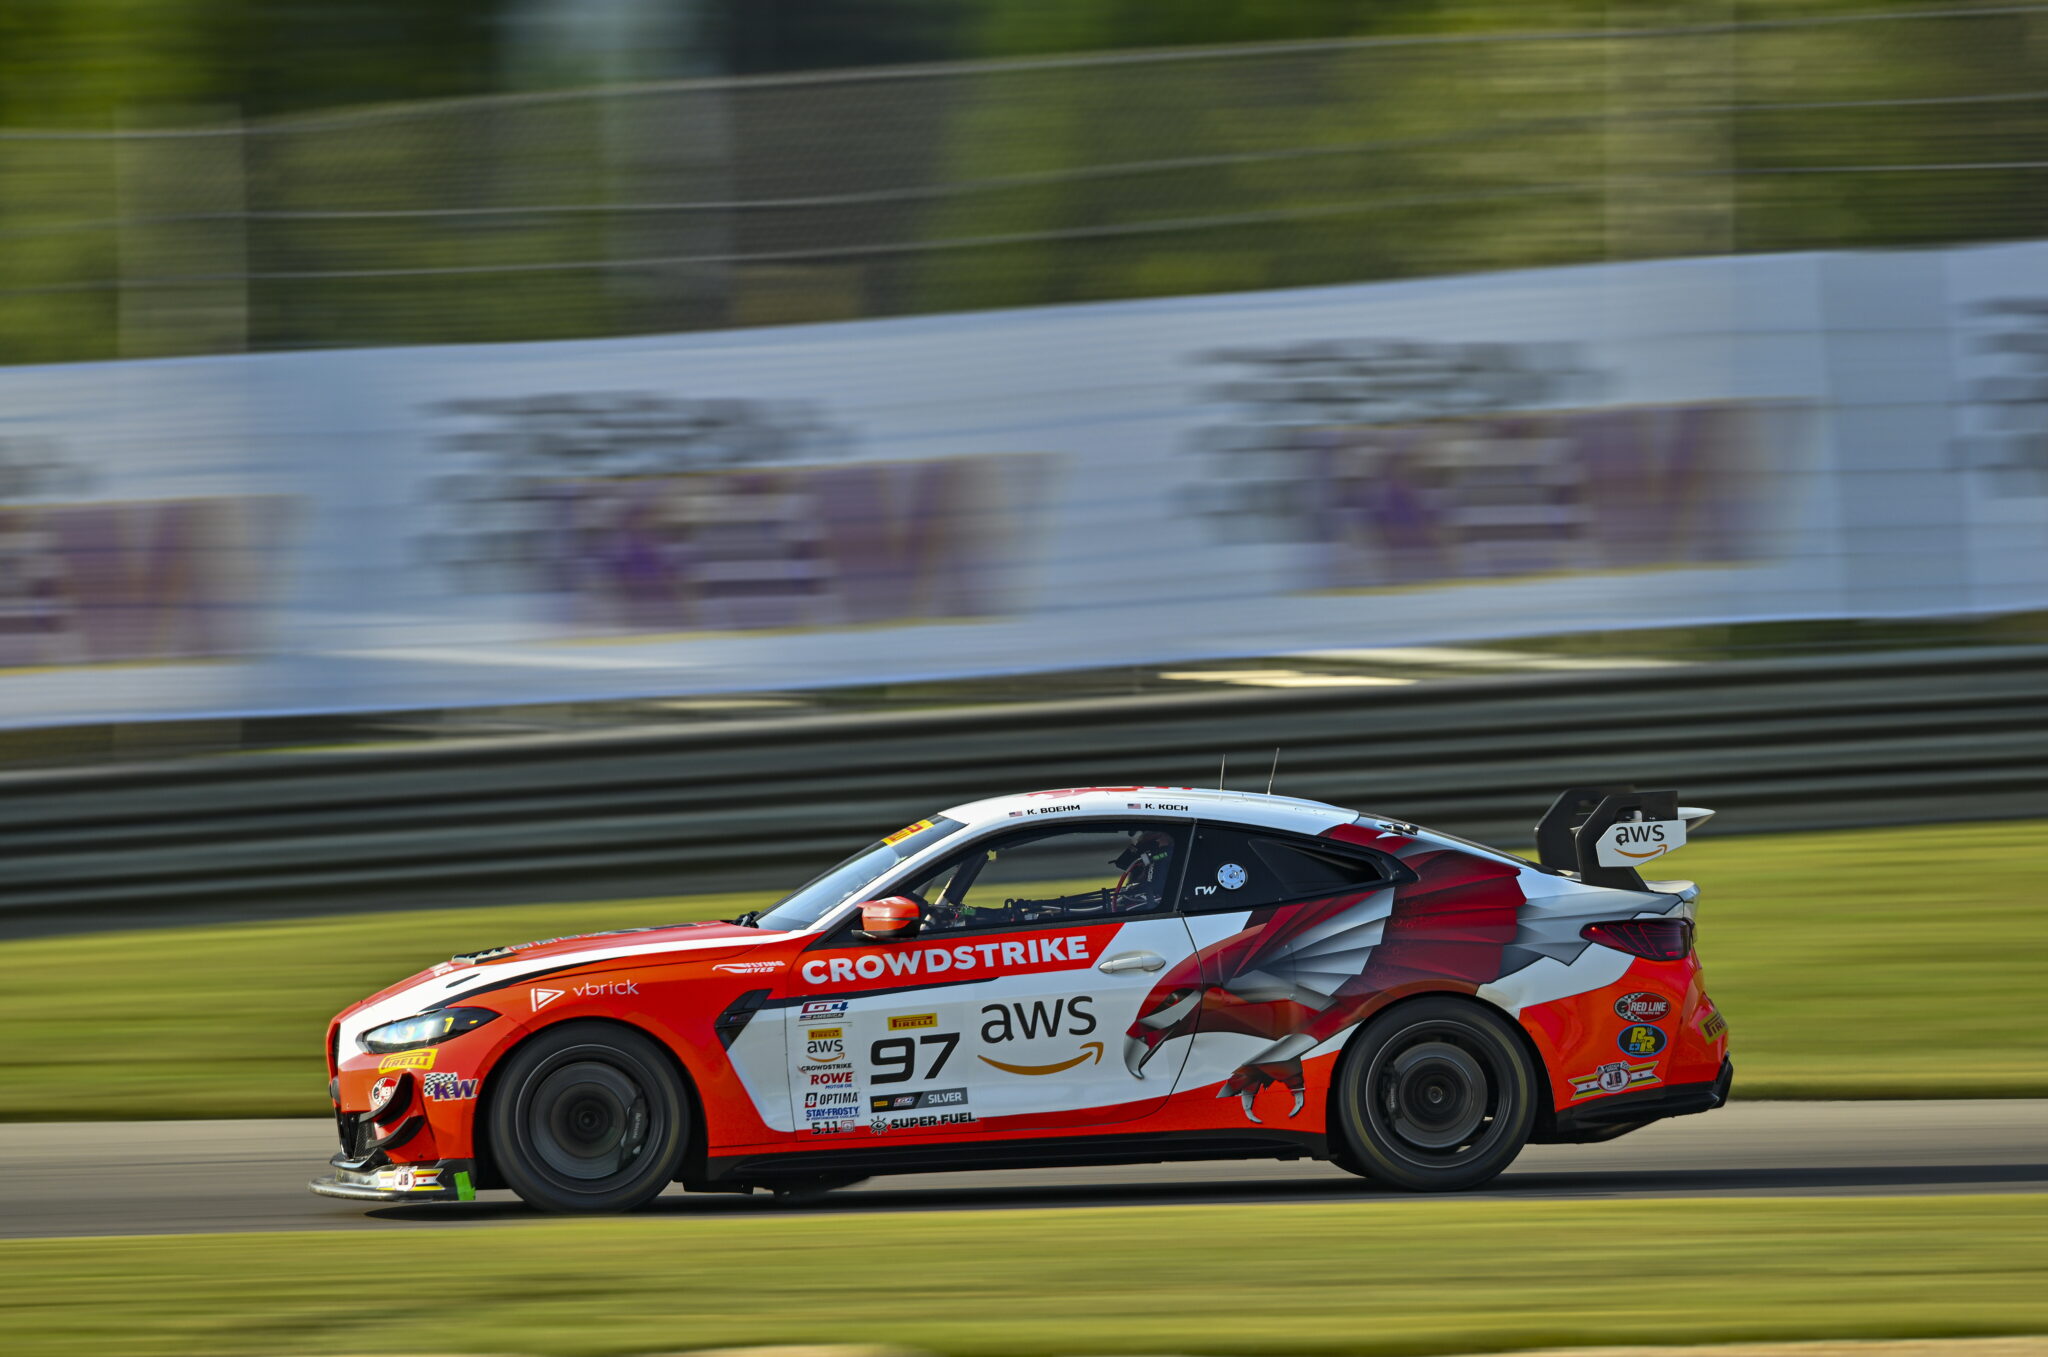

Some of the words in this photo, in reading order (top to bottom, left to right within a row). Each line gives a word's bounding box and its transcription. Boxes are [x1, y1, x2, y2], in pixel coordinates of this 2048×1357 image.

[1040, 804, 1081, 814] BOEHM
[1615, 824, 1665, 843] aws
[802, 935, 1090, 985] CROWDSTRIKE
[746, 966, 775, 974] EYES
[572, 979, 640, 997] vbrick
[1630, 1001, 1648, 1012] RED
[1648, 1001, 1667, 1012] LINE
[892, 1015, 933, 1028] PIRELLI
[981, 996, 1097, 1044] aws
[807, 1039, 844, 1054] aws
[382, 1051, 429, 1069] PIRELLI
[870, 1032, 960, 1086] 97
[801, 1062, 852, 1072] CROWDSTRIKE
[810, 1071, 854, 1085] ROWE
[433, 1080, 477, 1101] KW
[928, 1092, 962, 1104] SILVER
[820, 1092, 858, 1105] OPTIMA
[806, 1106, 859, 1117] STAY-FROSTY
[811, 1120, 840, 1135] 5.11
[891, 1115, 937, 1129] SUPER
[941, 1112, 976, 1125] FUEL
